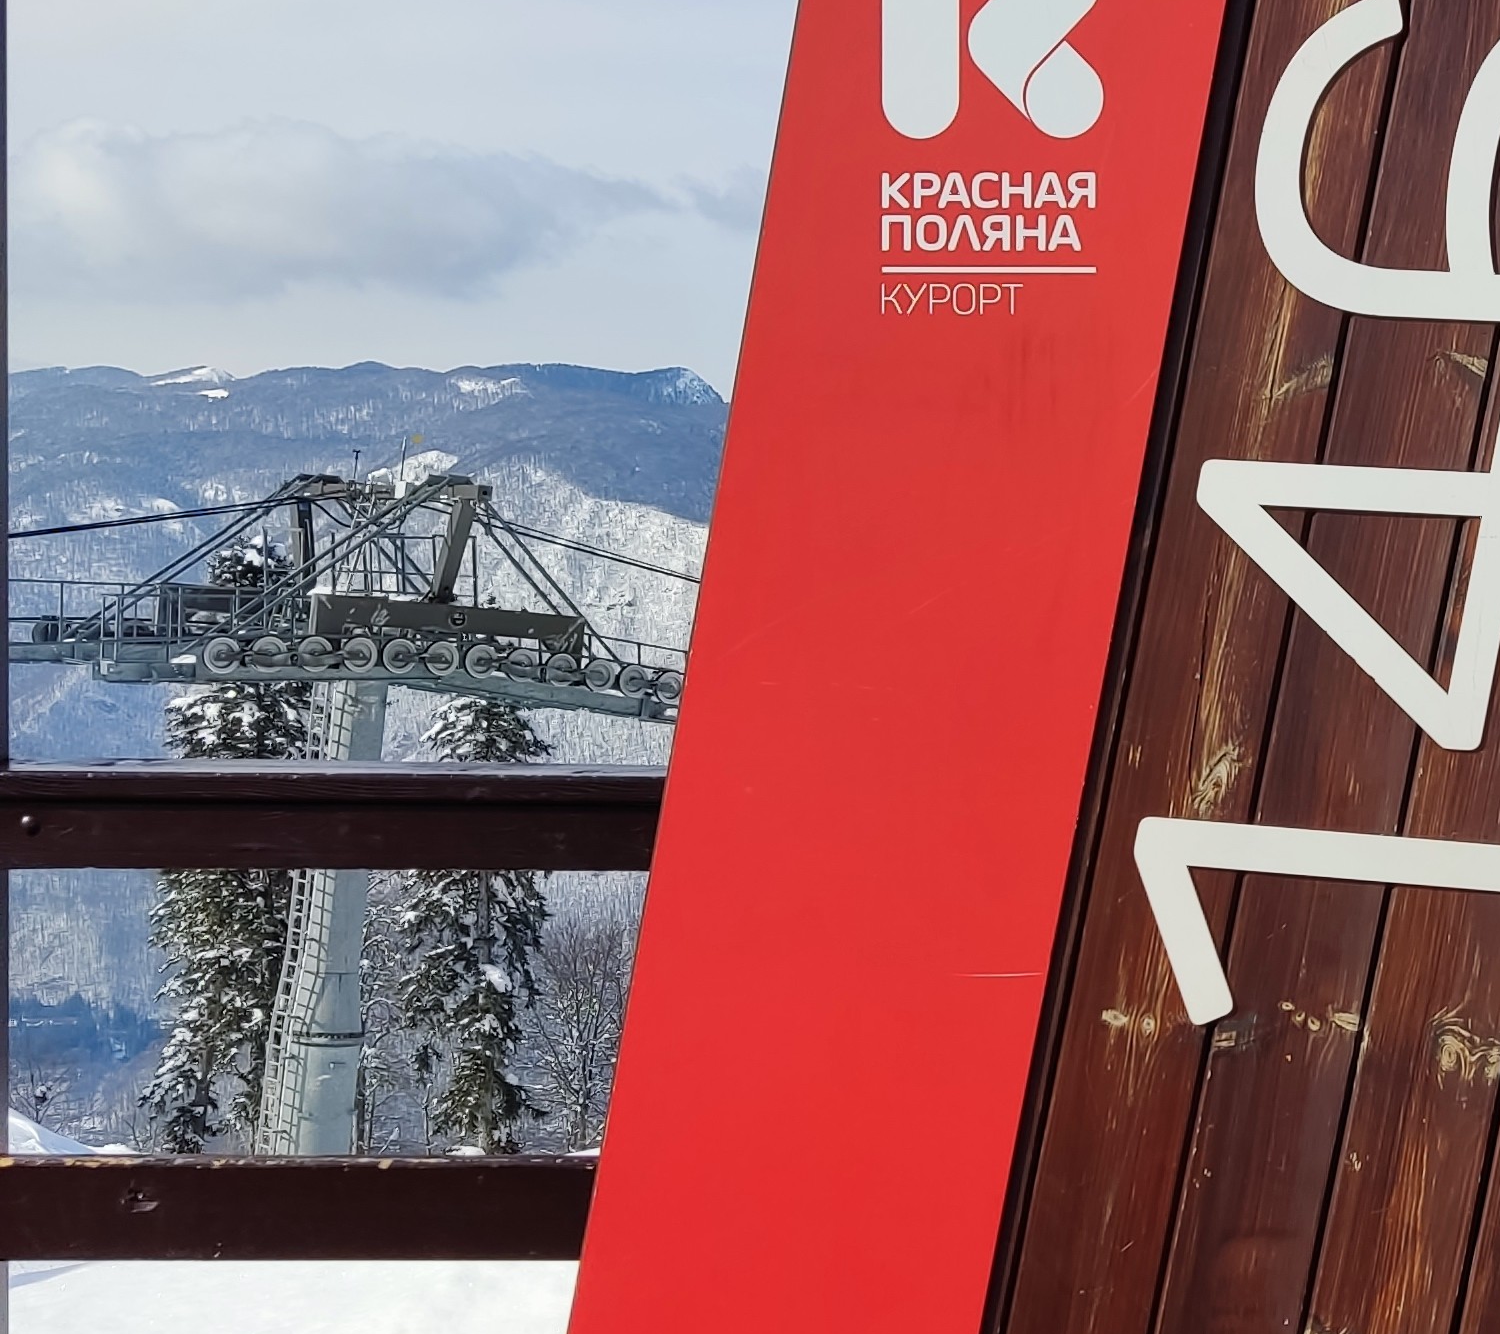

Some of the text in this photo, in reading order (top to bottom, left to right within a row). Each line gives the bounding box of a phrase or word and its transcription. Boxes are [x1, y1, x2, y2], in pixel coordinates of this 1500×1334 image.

[881, 171, 1097, 209] КРАСНАЯ
[881, 214, 1082, 252] ПОЛЯНА
[881, 283, 1024, 315] КУРОРТ
